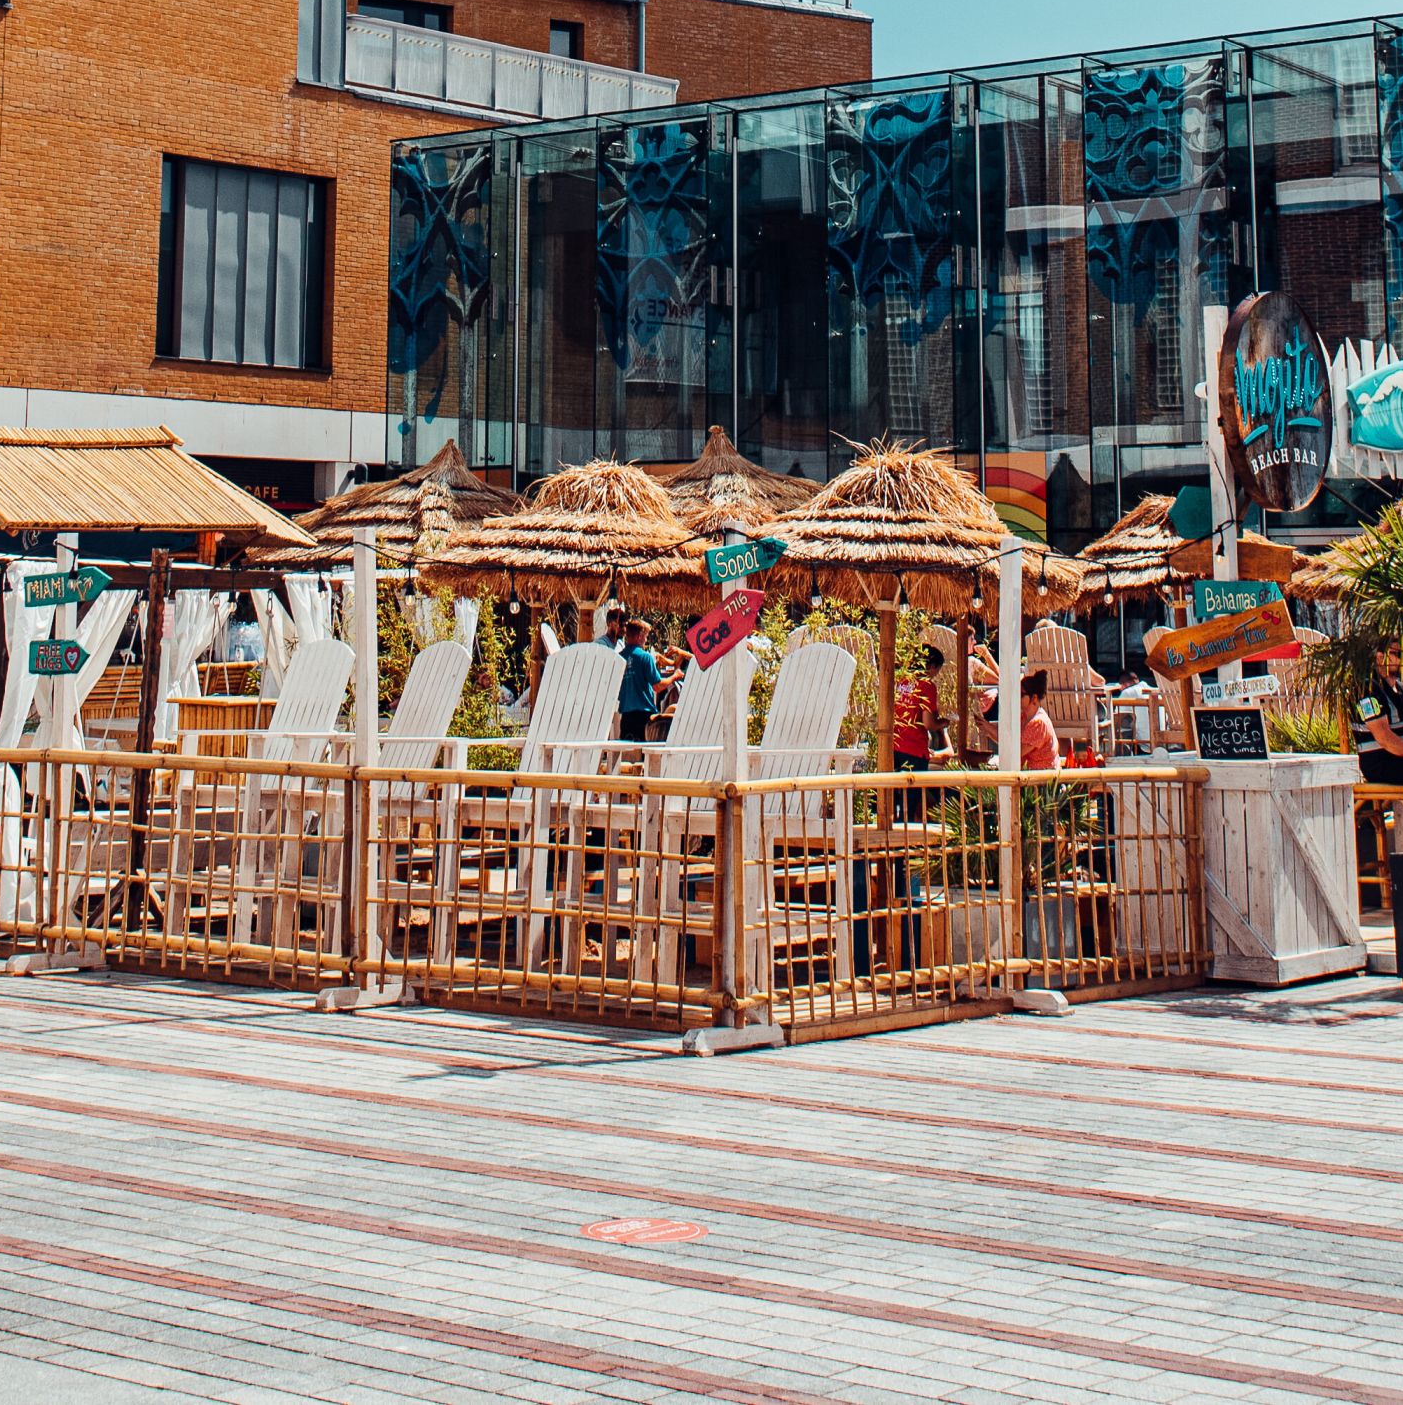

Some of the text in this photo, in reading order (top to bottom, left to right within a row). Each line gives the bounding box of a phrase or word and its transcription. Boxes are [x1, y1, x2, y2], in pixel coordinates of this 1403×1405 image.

[1250, 448, 1318, 475] BEACH BAR
[715, 545, 760, 578] Sopot
[26, 576, 65, 603] MIAMI
[1204, 587, 1257, 612] Bahamas
[724, 592, 748, 616] 7716
[696, 620, 731, 654] Goa
[38, 644, 62, 658] FREE
[1188, 638, 1237, 662] Summer
[1205, 685, 1222, 700] COLD
[1200, 715, 1252, 731] Staff
[1200, 730, 1261, 748] NEEDED
